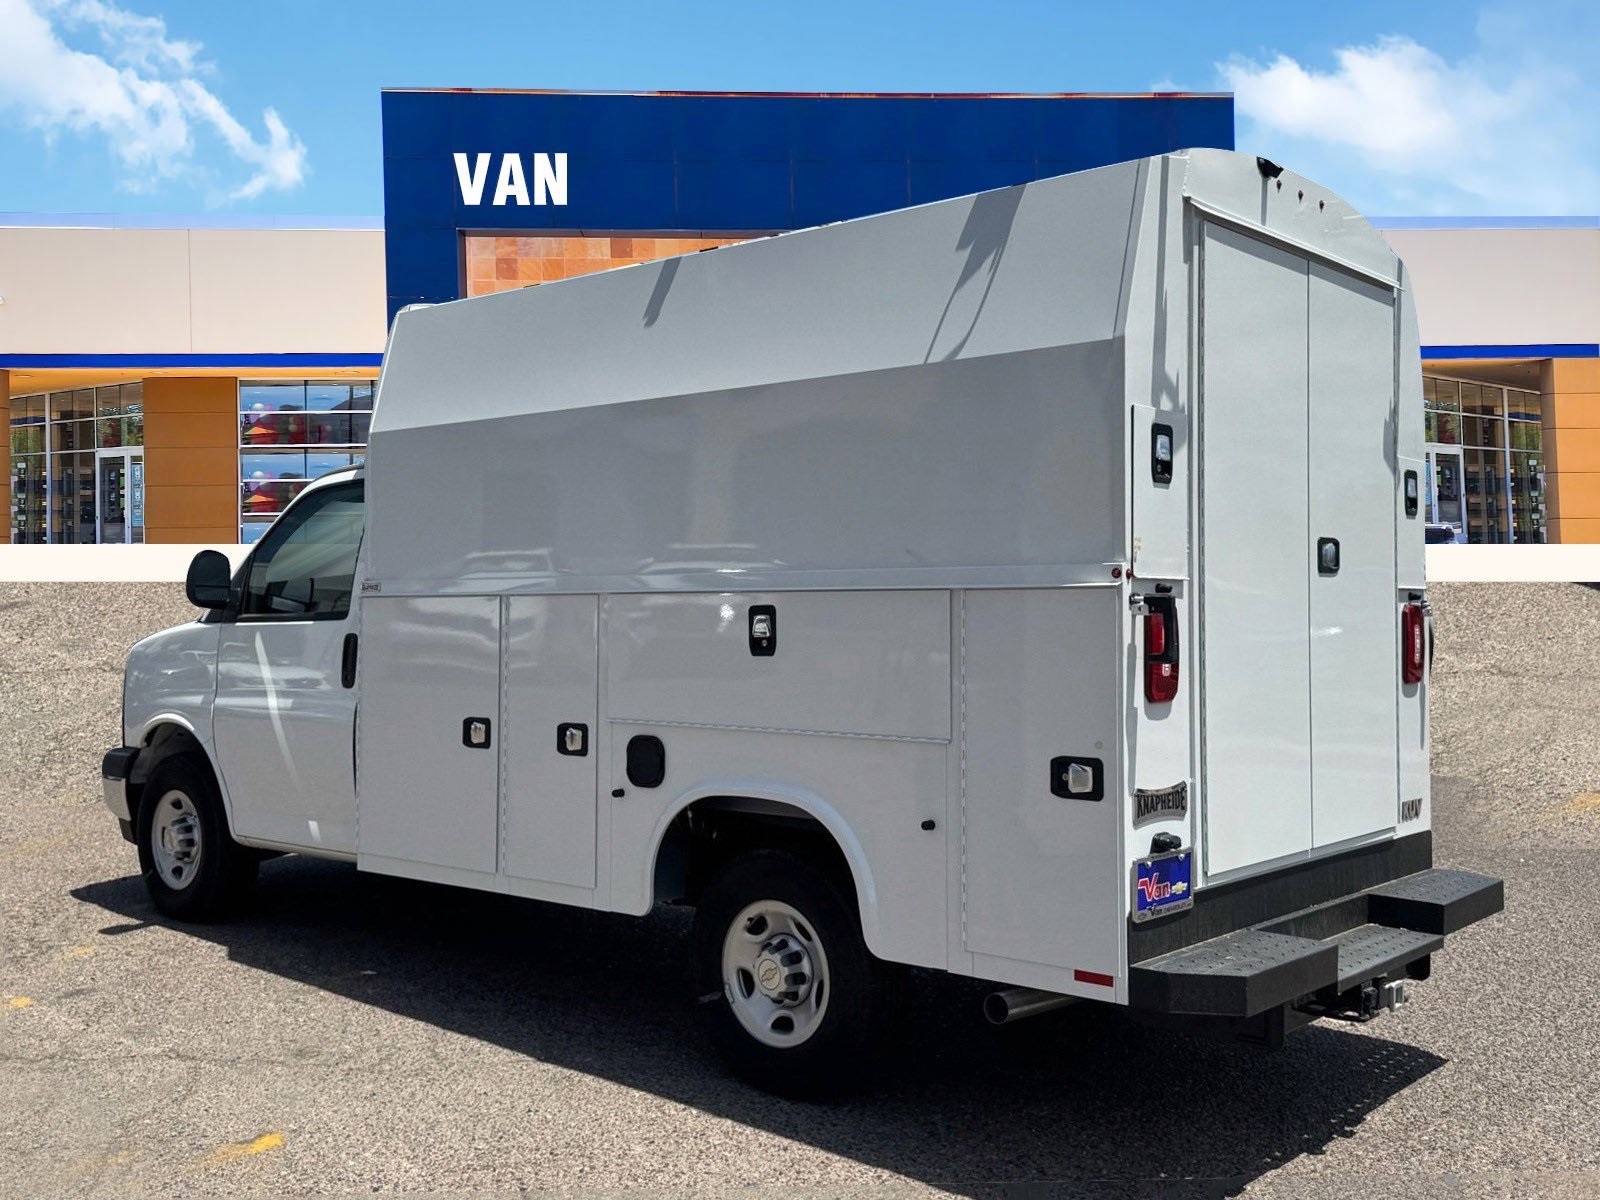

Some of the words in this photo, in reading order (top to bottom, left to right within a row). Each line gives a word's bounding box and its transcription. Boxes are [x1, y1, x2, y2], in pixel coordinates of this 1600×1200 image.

[453, 153, 568, 205] VAN
[1136, 788, 1186, 819] KNAPHEIDE
[1138, 872, 1171, 902] Van
